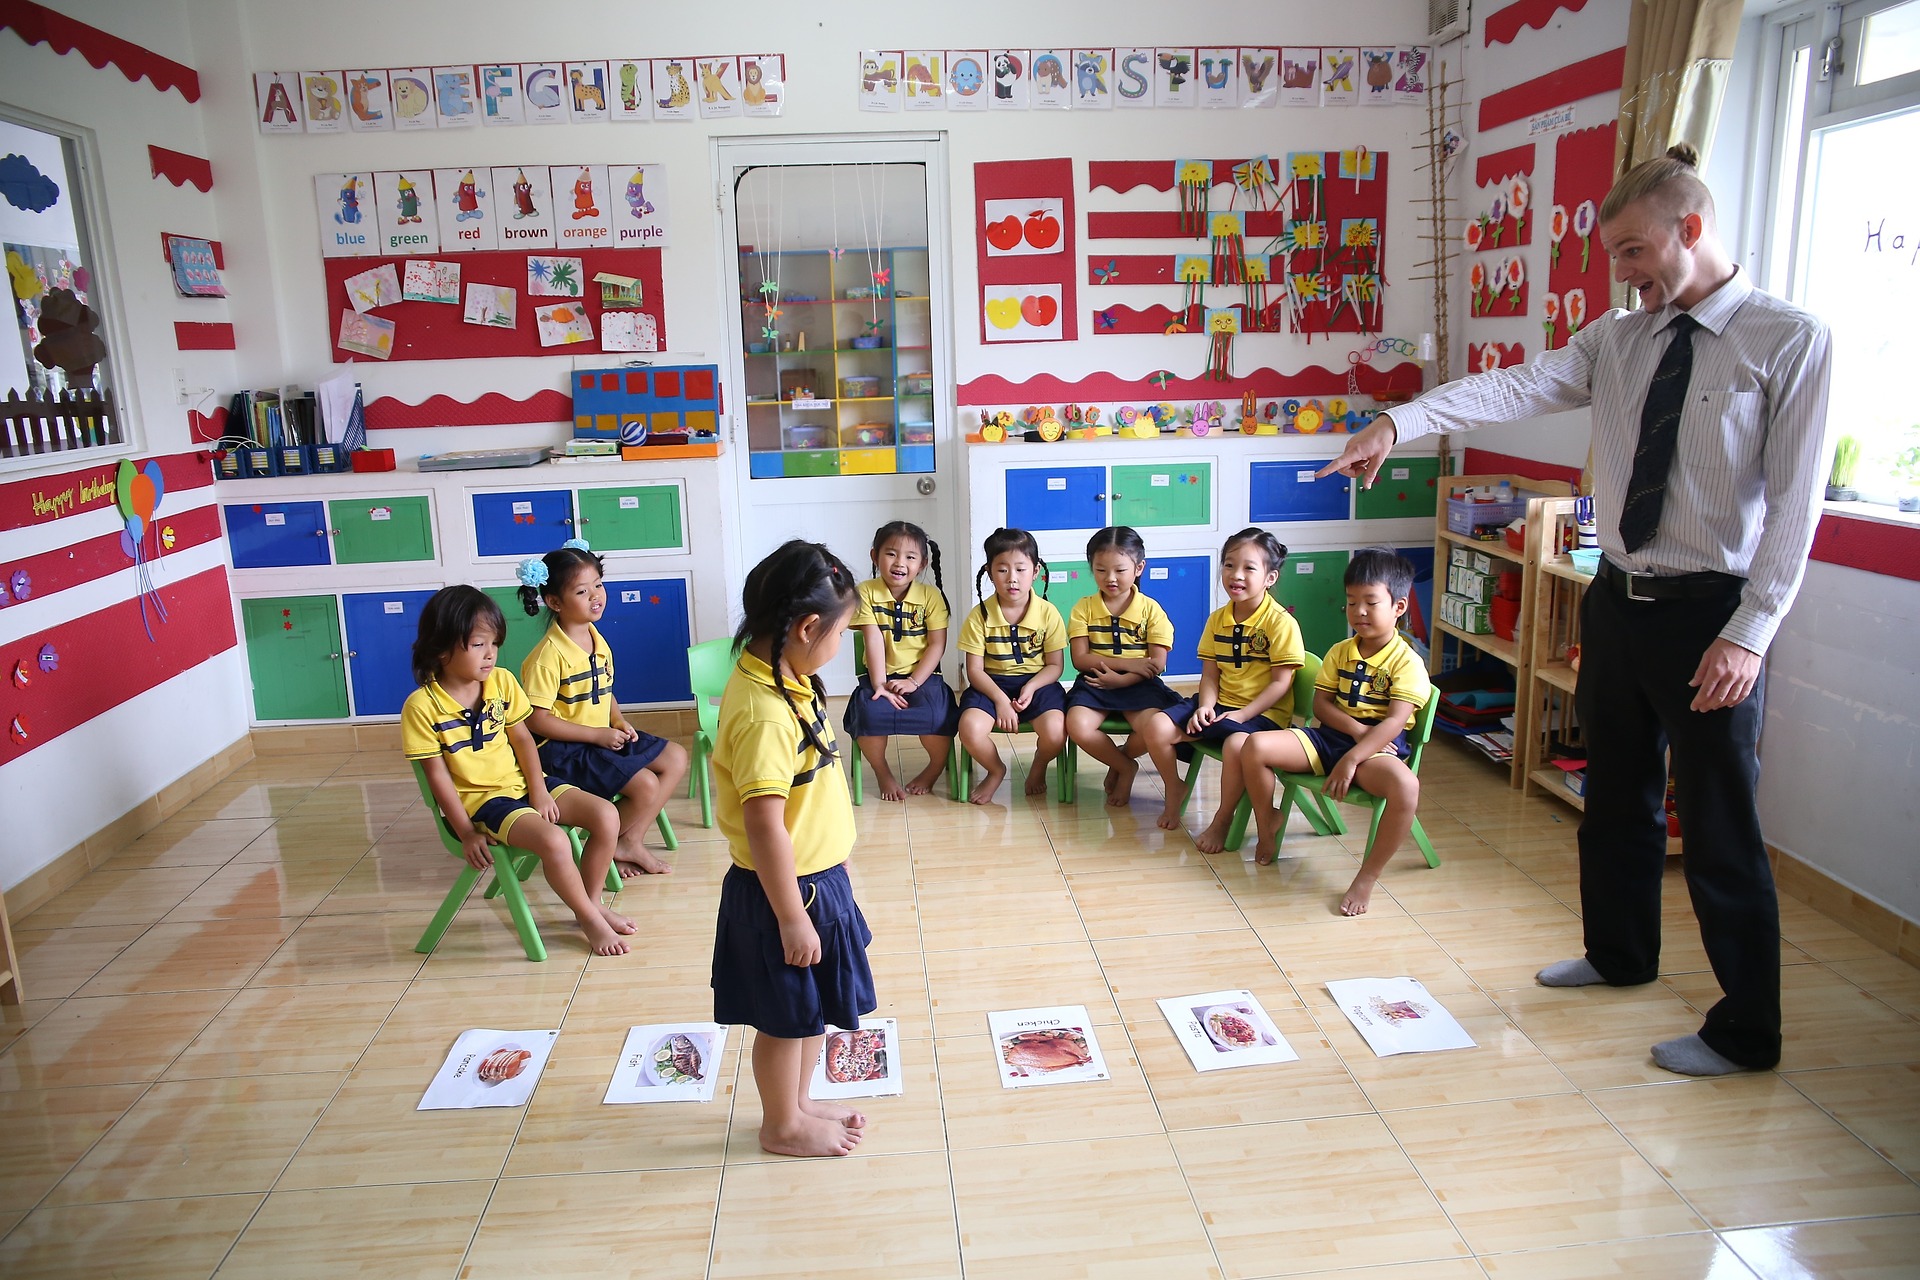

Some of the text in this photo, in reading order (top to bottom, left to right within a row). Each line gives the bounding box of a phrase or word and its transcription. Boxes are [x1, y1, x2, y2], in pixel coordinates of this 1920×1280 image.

[907, 57, 941, 97] N
[994, 54, 1022, 99] P
[1118, 53, 1149, 98] S
[1200, 58, 1233, 89] U
[1323, 56, 1354, 92] X
[1395, 51, 1426, 92] Z
[263, 83, 297, 123] A
[350, 77, 383, 121] C
[484, 68, 512, 116] F
[526, 69, 560, 109] G
[570, 68, 606, 112] H
[699, 62, 736, 102] K
[744, 61, 777, 105] L
[336, 233, 365, 245] blue
[390, 234, 428, 247] green
[458, 227, 481, 240] red
[504, 227, 548, 239] brown
[563, 227, 607, 239] orange
[620, 225, 663, 241] purple
[32, 472, 118, 518] Happy birthday
[1017, 1019, 1061, 1027] Chicken
[1352, 1005, 1374, 1027] Popcorn
[1187, 1020, 1202, 1038] Pasta
[453, 1053, 477, 1079] Pancake
[628, 1054, 643, 1068] Fish
